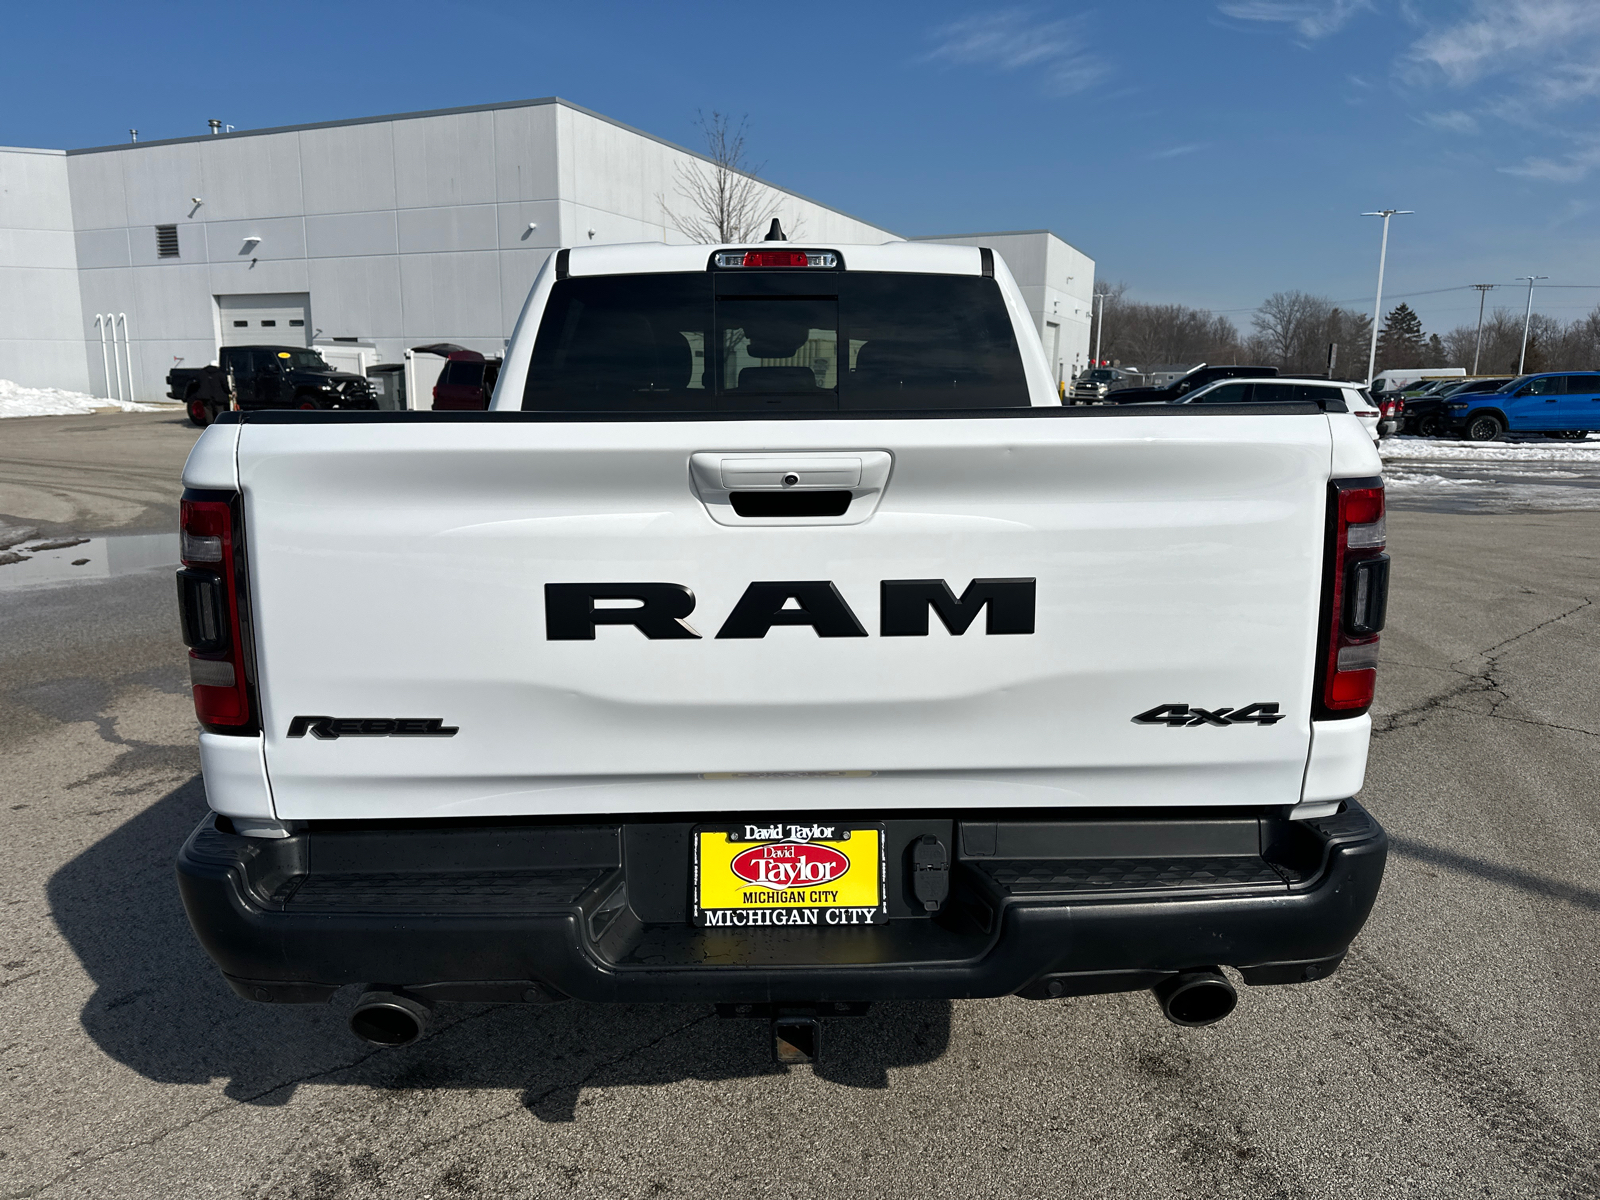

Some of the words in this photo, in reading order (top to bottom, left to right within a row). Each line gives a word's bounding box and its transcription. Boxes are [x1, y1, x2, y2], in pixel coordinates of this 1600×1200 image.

[544, 577, 1036, 640] RAM
[1130, 702, 1286, 727] 4x4
[286, 716, 460, 740] REBEL
[744, 824, 783, 840] David
[784, 824, 835, 843] Taylor
[763, 846, 795, 858] David
[746, 856, 837, 889] Taylor
[743, 891, 805, 904] MICHIGAN
[809, 890, 838, 903] CITY
[705, 909, 819, 926] MICHIGAN
[825, 908, 877, 925] CITY
